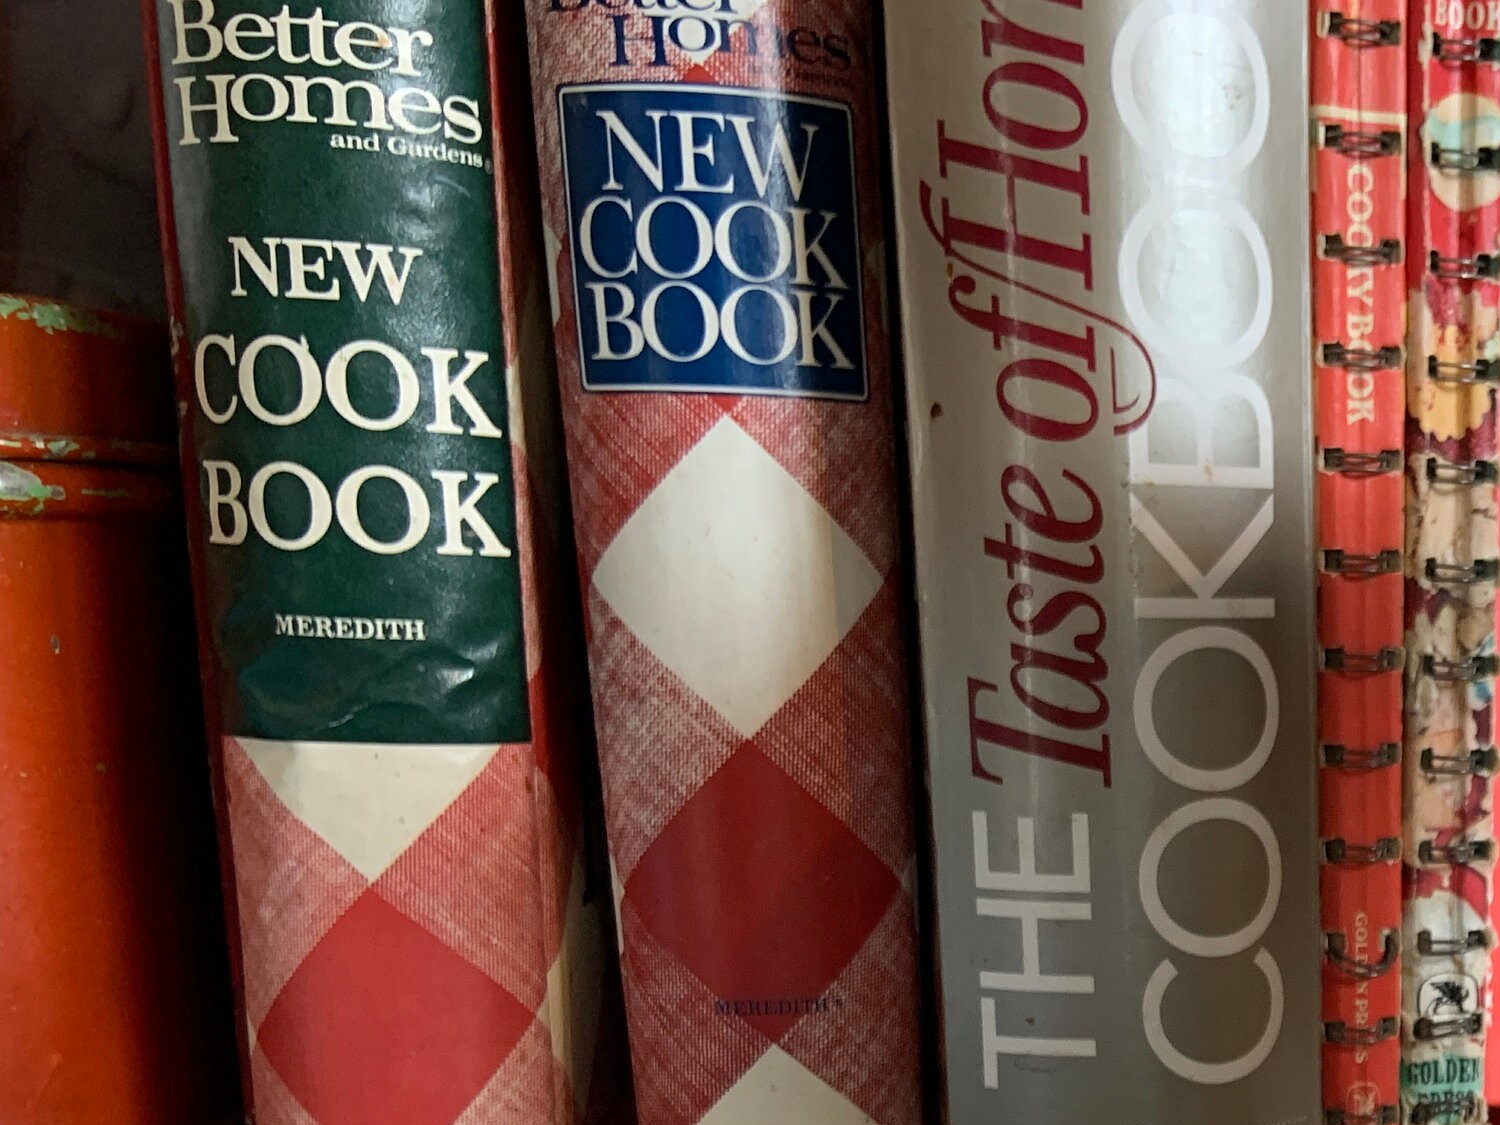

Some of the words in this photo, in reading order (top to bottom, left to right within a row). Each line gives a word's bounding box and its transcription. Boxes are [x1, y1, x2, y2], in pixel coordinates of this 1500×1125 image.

[172, 0, 434, 77] Better
[174, 73, 483, 145] Homes
[330, 133, 380, 152] and
[387, 138, 484, 169] Gardens
[595, 110, 821, 200] NEW
[228, 236, 423, 306] NEW
[578, 195, 851, 290] COOK
[585, 280, 857, 371] BOOK
[195, 334, 502, 439] COOK
[203, 460, 512, 558] BOOK
[274, 613, 427, 642] MEREDITH
[966, 464, 1113, 789] Taste
[970, 811, 1097, 1090] THE
